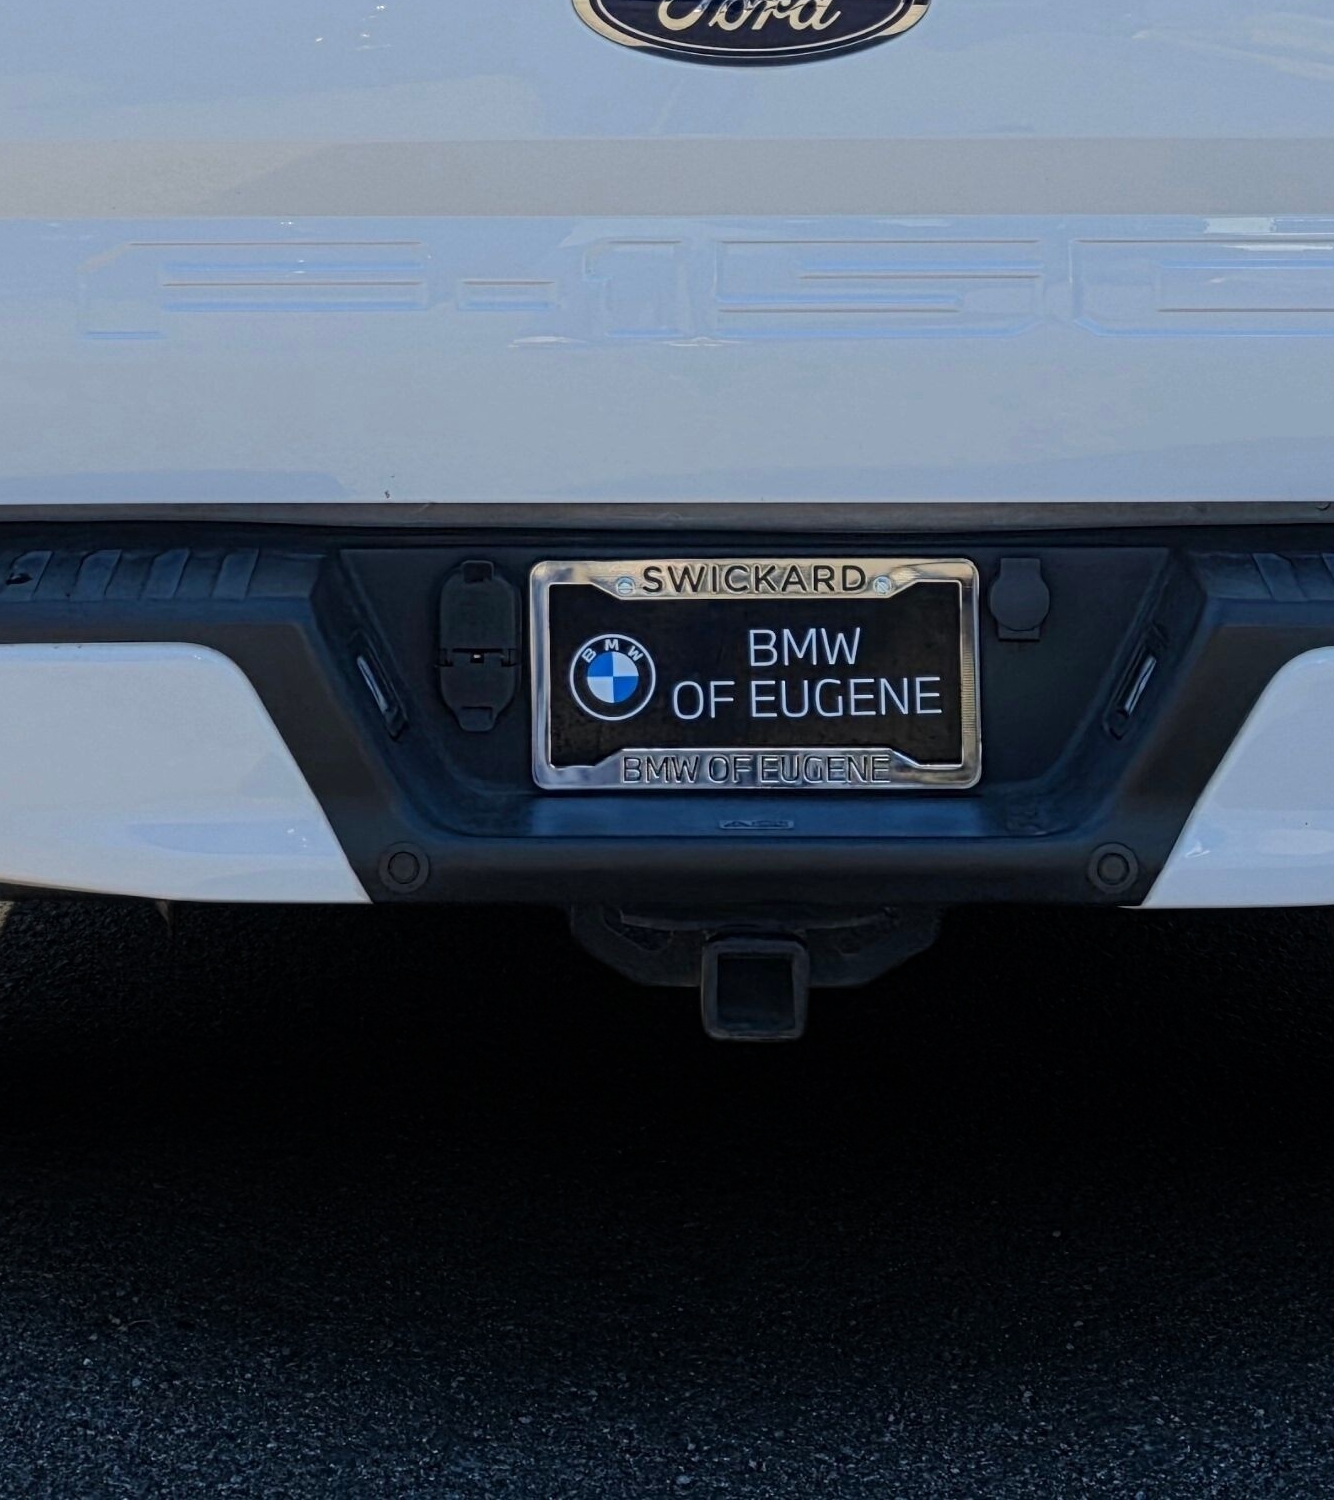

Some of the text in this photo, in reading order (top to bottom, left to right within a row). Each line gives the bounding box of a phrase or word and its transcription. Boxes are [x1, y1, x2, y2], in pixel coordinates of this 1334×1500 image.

[641, 564, 868, 594] SWICKARD
[580, 637, 644, 664] BMW
[749, 626, 862, 668] BMW
[672, 676, 943, 720] OF EUGENE
[621, 754, 892, 785] BMW OF EUGENE
